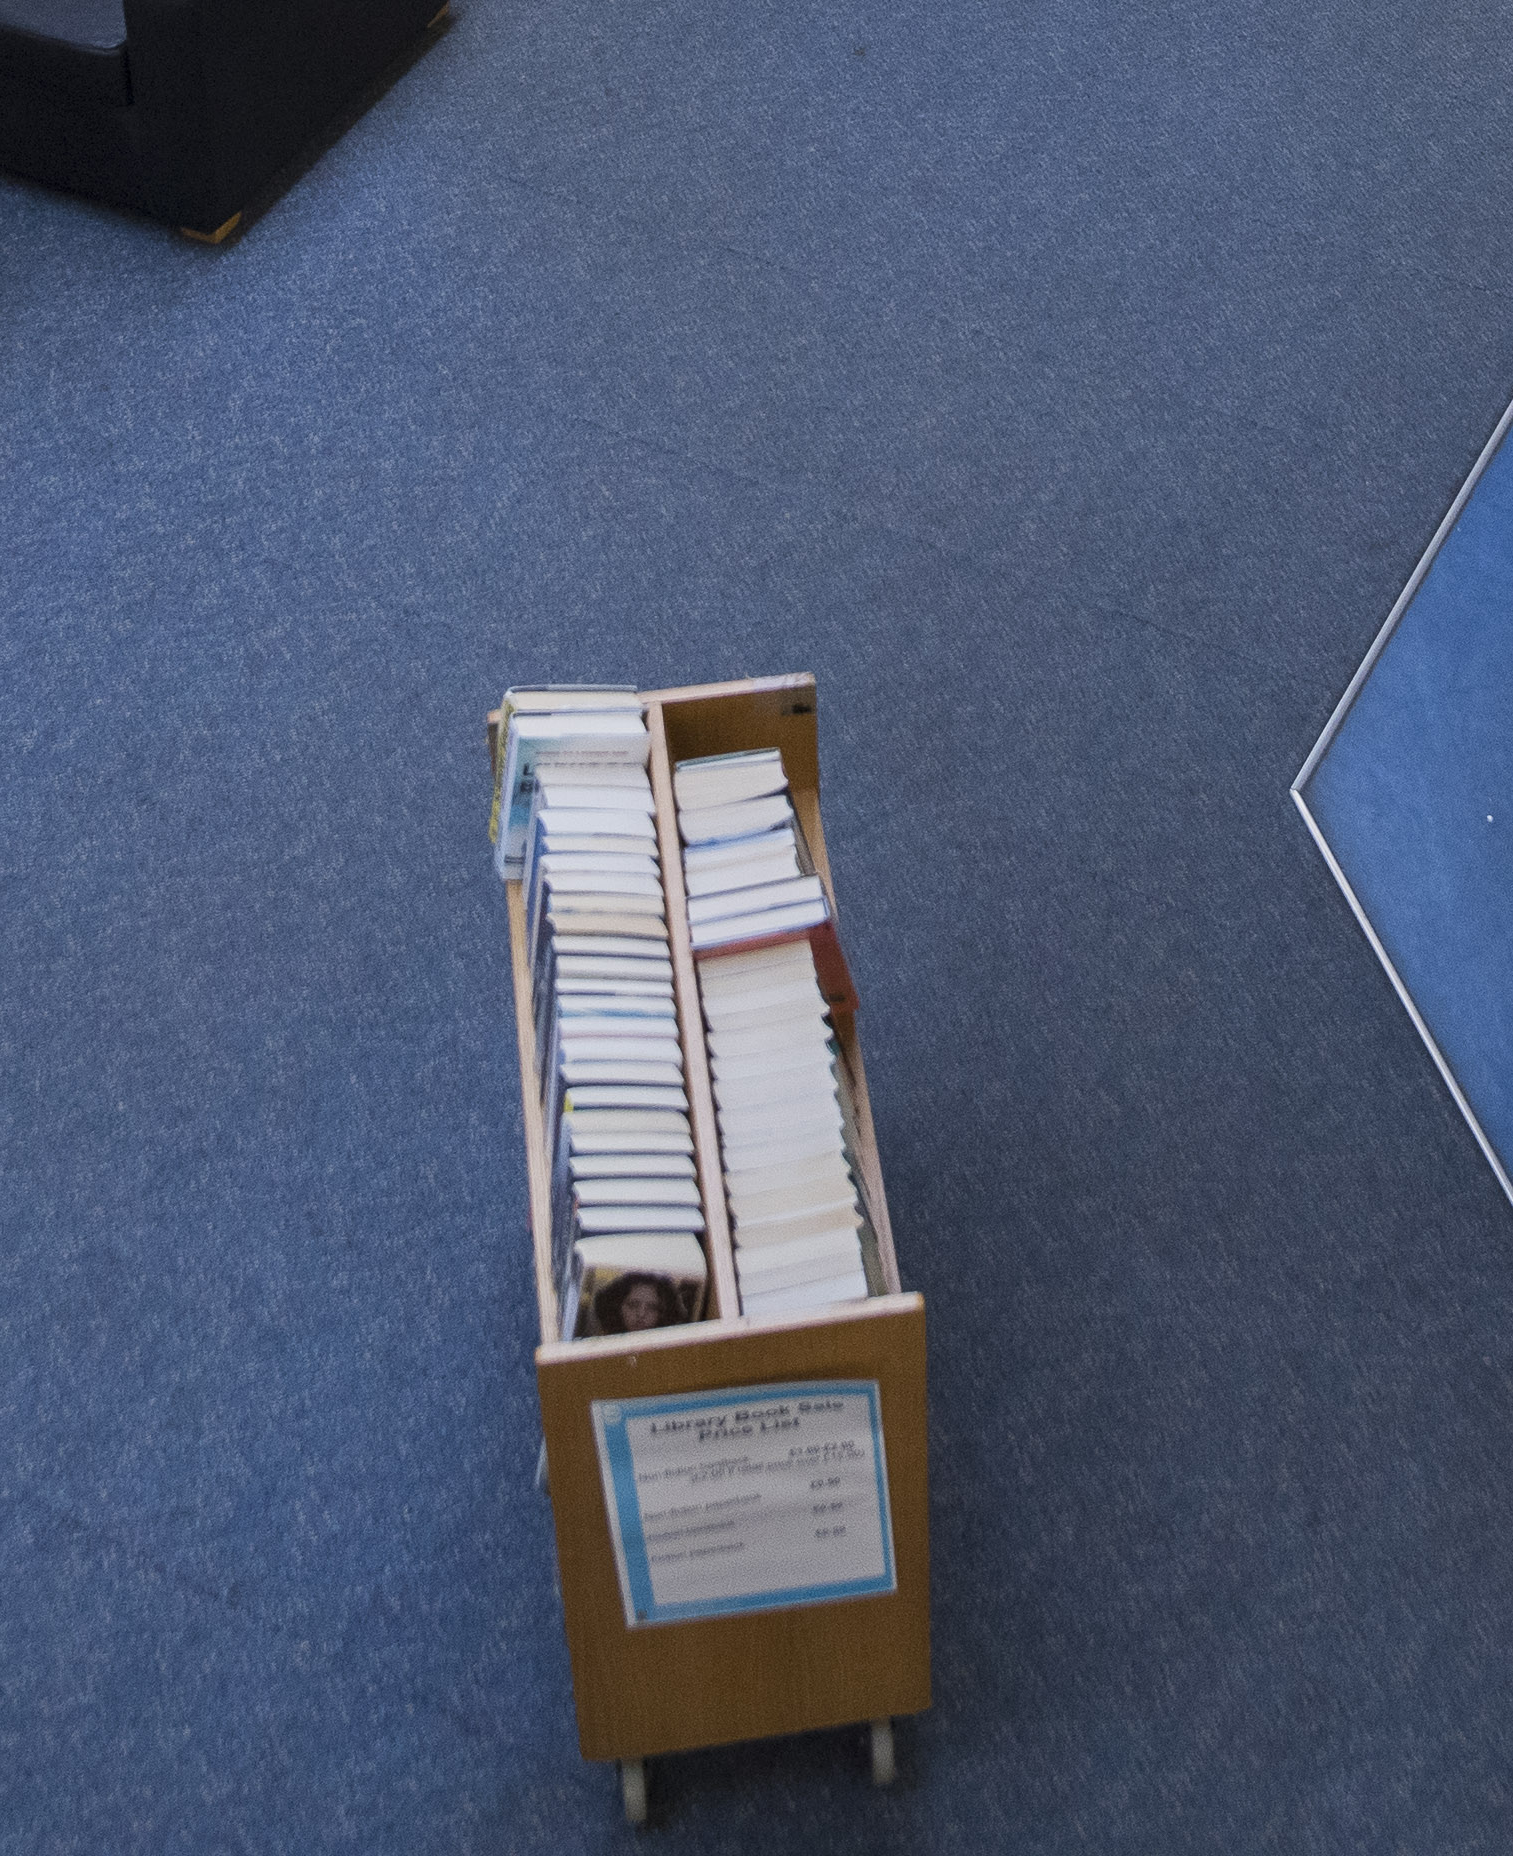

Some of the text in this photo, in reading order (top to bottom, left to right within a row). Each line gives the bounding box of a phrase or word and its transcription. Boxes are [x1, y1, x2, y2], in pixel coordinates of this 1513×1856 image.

[651, 1399, 844, 1434] Library Book Sale
[698, 1417, 800, 1441] Price List
